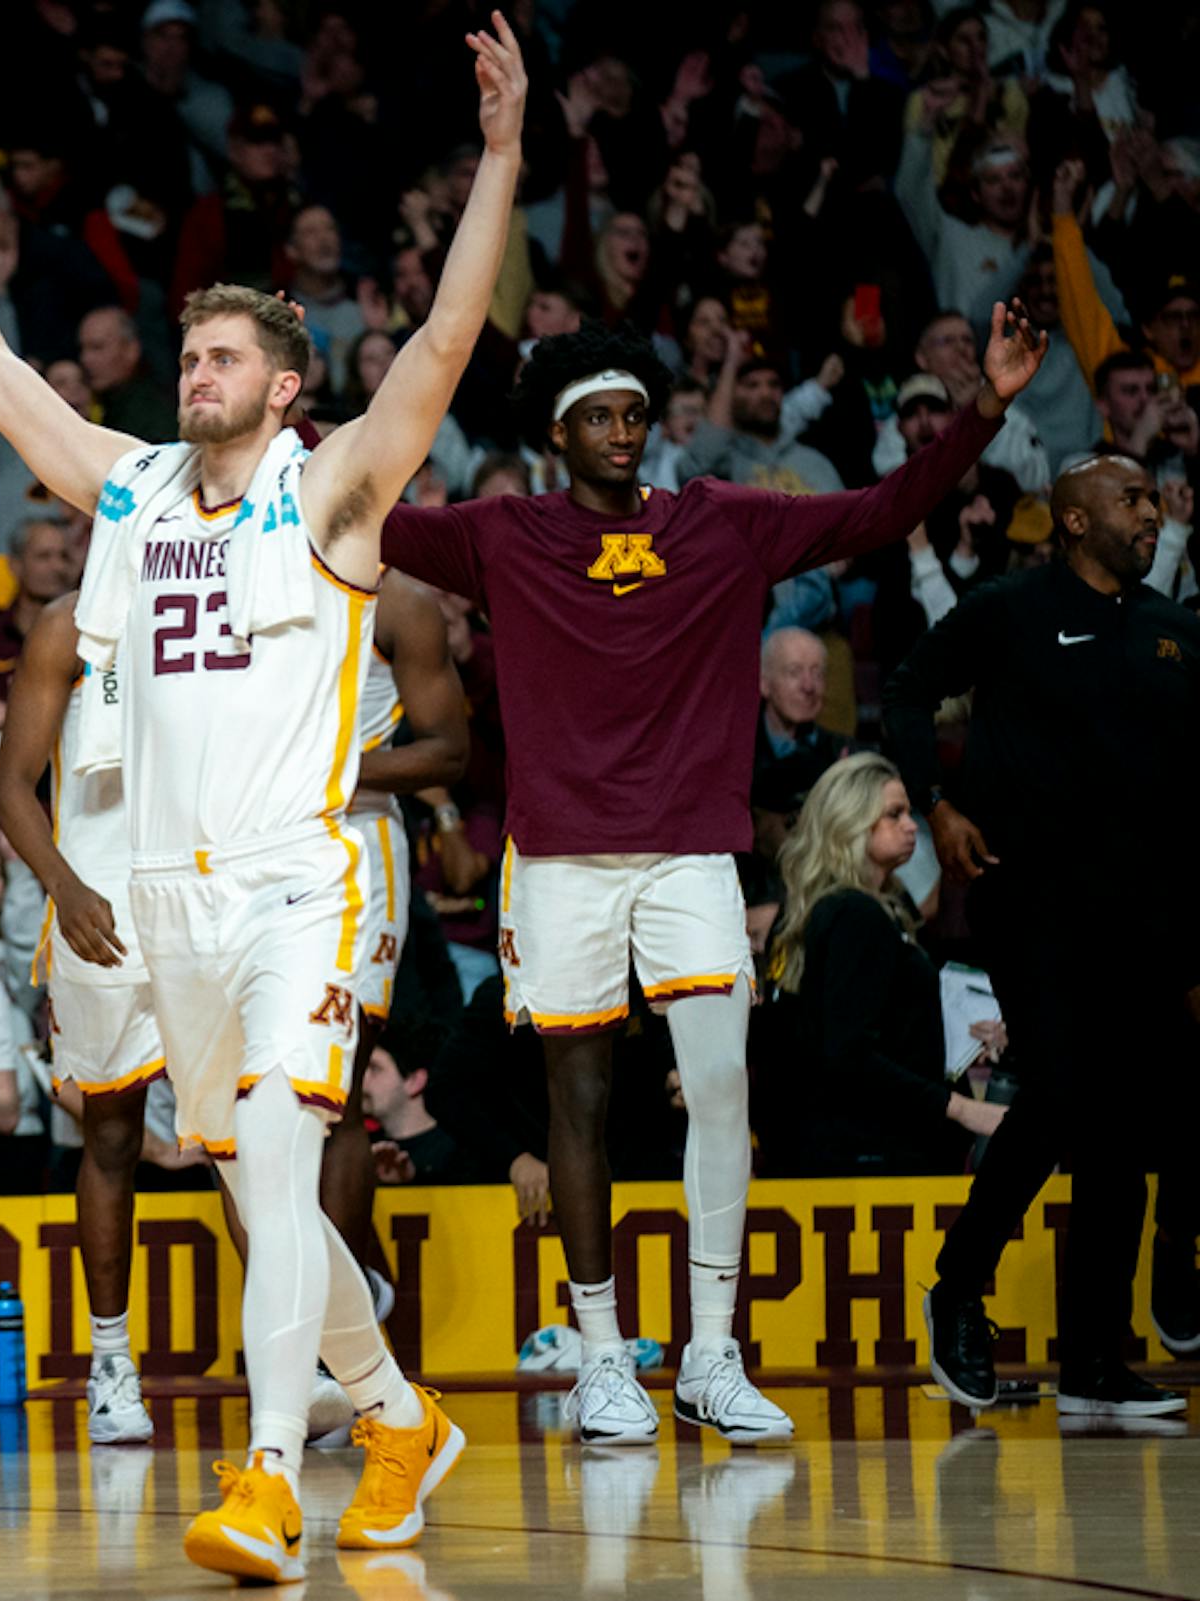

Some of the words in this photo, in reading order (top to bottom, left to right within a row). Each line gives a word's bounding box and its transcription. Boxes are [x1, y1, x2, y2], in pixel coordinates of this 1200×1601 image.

[141, 539, 231, 583] MINNES
[587, 533, 667, 580] M
[153, 591, 253, 677] 23
